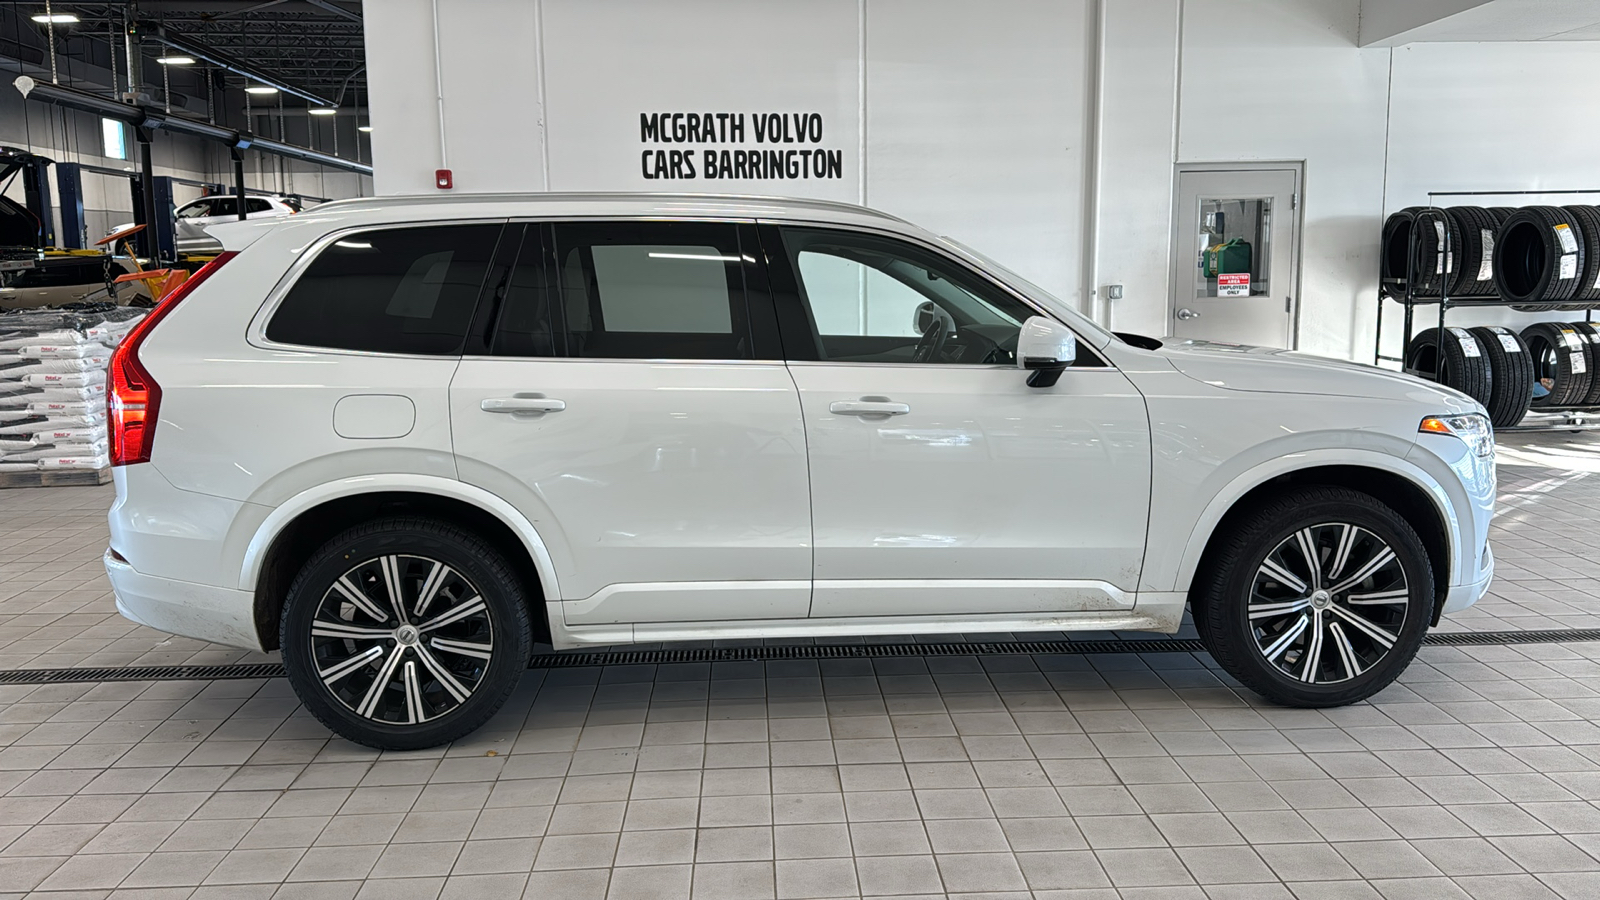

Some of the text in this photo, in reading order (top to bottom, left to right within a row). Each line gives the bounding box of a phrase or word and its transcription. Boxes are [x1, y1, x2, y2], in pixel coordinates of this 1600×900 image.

[641, 113, 822, 143] MCGRATH VOLVO
[642, 149, 841, 179] CARS BARRINGTON
